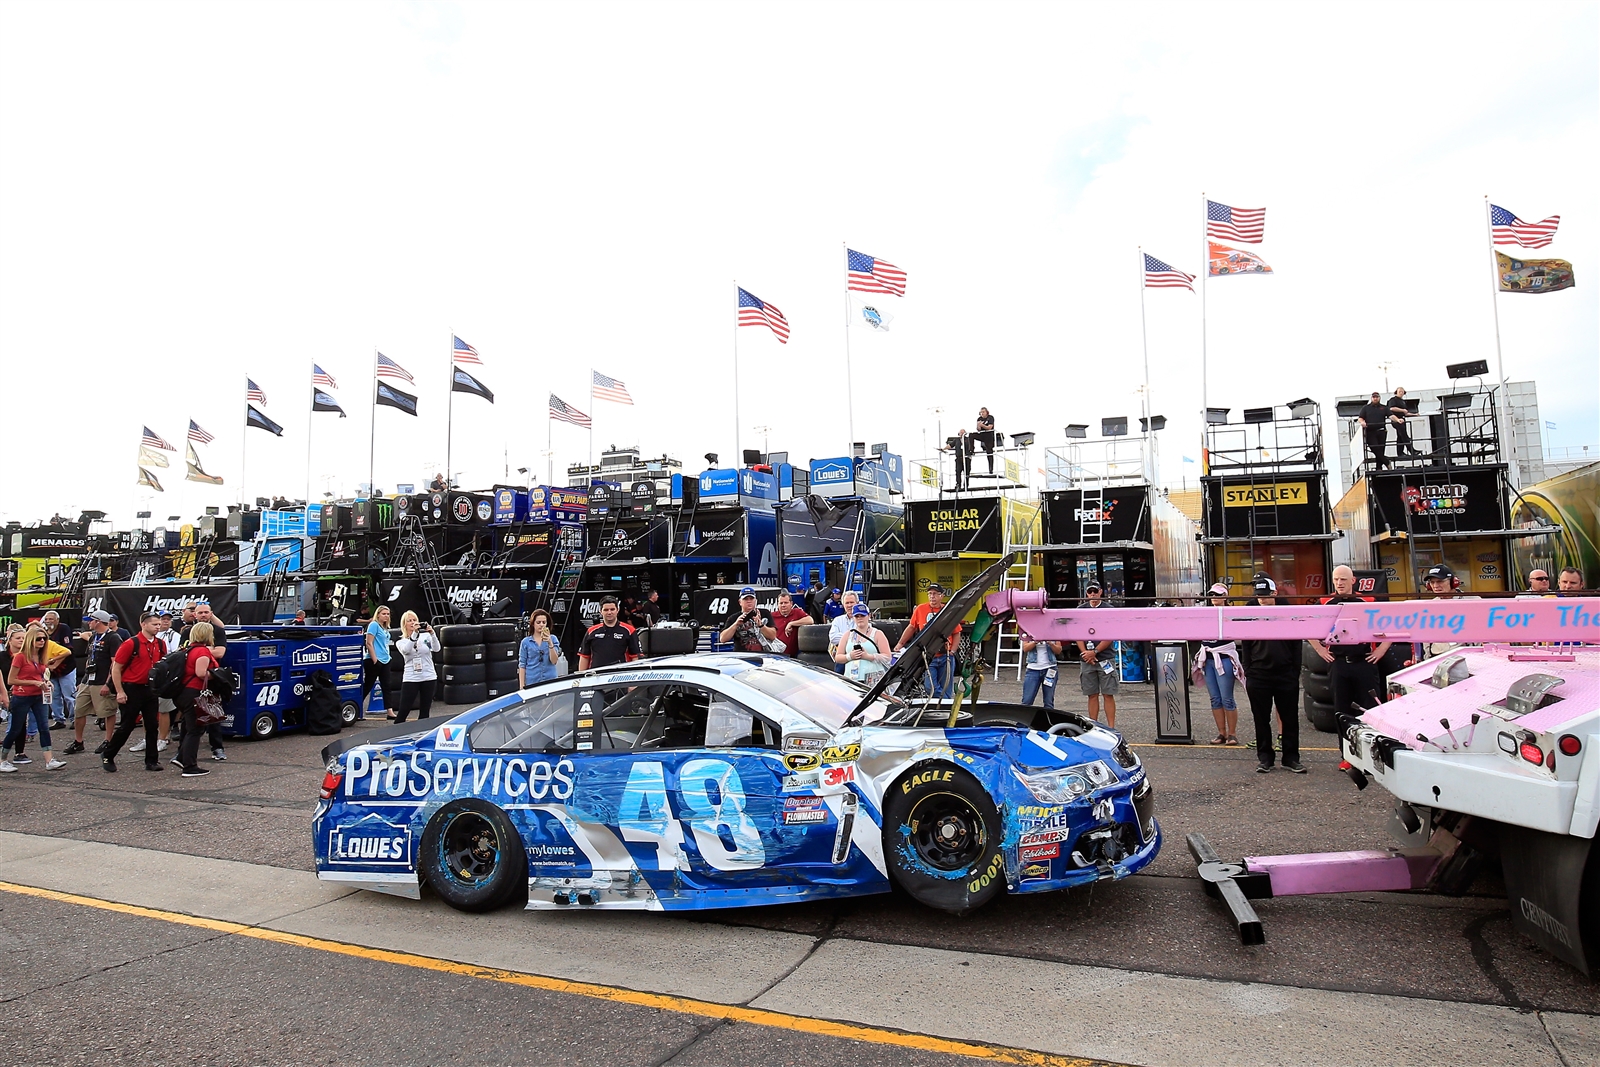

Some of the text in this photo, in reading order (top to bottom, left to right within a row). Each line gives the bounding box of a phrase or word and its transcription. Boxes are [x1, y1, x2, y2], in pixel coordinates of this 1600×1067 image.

[818, 469, 846, 480] LOWE'S
[1226, 487, 1301, 502] STANLEY
[930, 508, 979, 521] DOLLAR
[928, 520, 981, 532] GENERAL
[30, 538, 85, 546] MENARDS
[1057, 583, 1068, 592] 11
[1133, 582, 1144, 591] 11
[1305, 574, 1323, 589] 19
[1359, 577, 1376, 592] 19
[387, 585, 403, 602] 5
[708, 597, 730, 615] 48
[1363, 608, 1466, 635] Towing
[1487, 606, 1535, 629] For
[296, 650, 328, 663] LOWE'S
[1163, 652, 1176, 663] 19
[607, 671, 674, 683] Jimmie Johnson
[255, 684, 281, 707] 48
[344, 750, 574, 800] ProServices
[823, 765, 855, 787] 3M
[901, 770, 955, 795] EAGLE
[787, 797, 821, 806] Duralast
[617, 758, 766, 872] 48
[785, 811, 827, 825] FLOWMASTER
[1021, 845, 1057, 860] Edelbrock
[1021, 866, 1049, 876] SUNOCO
[1520, 896, 1573, 950] CENTURY
